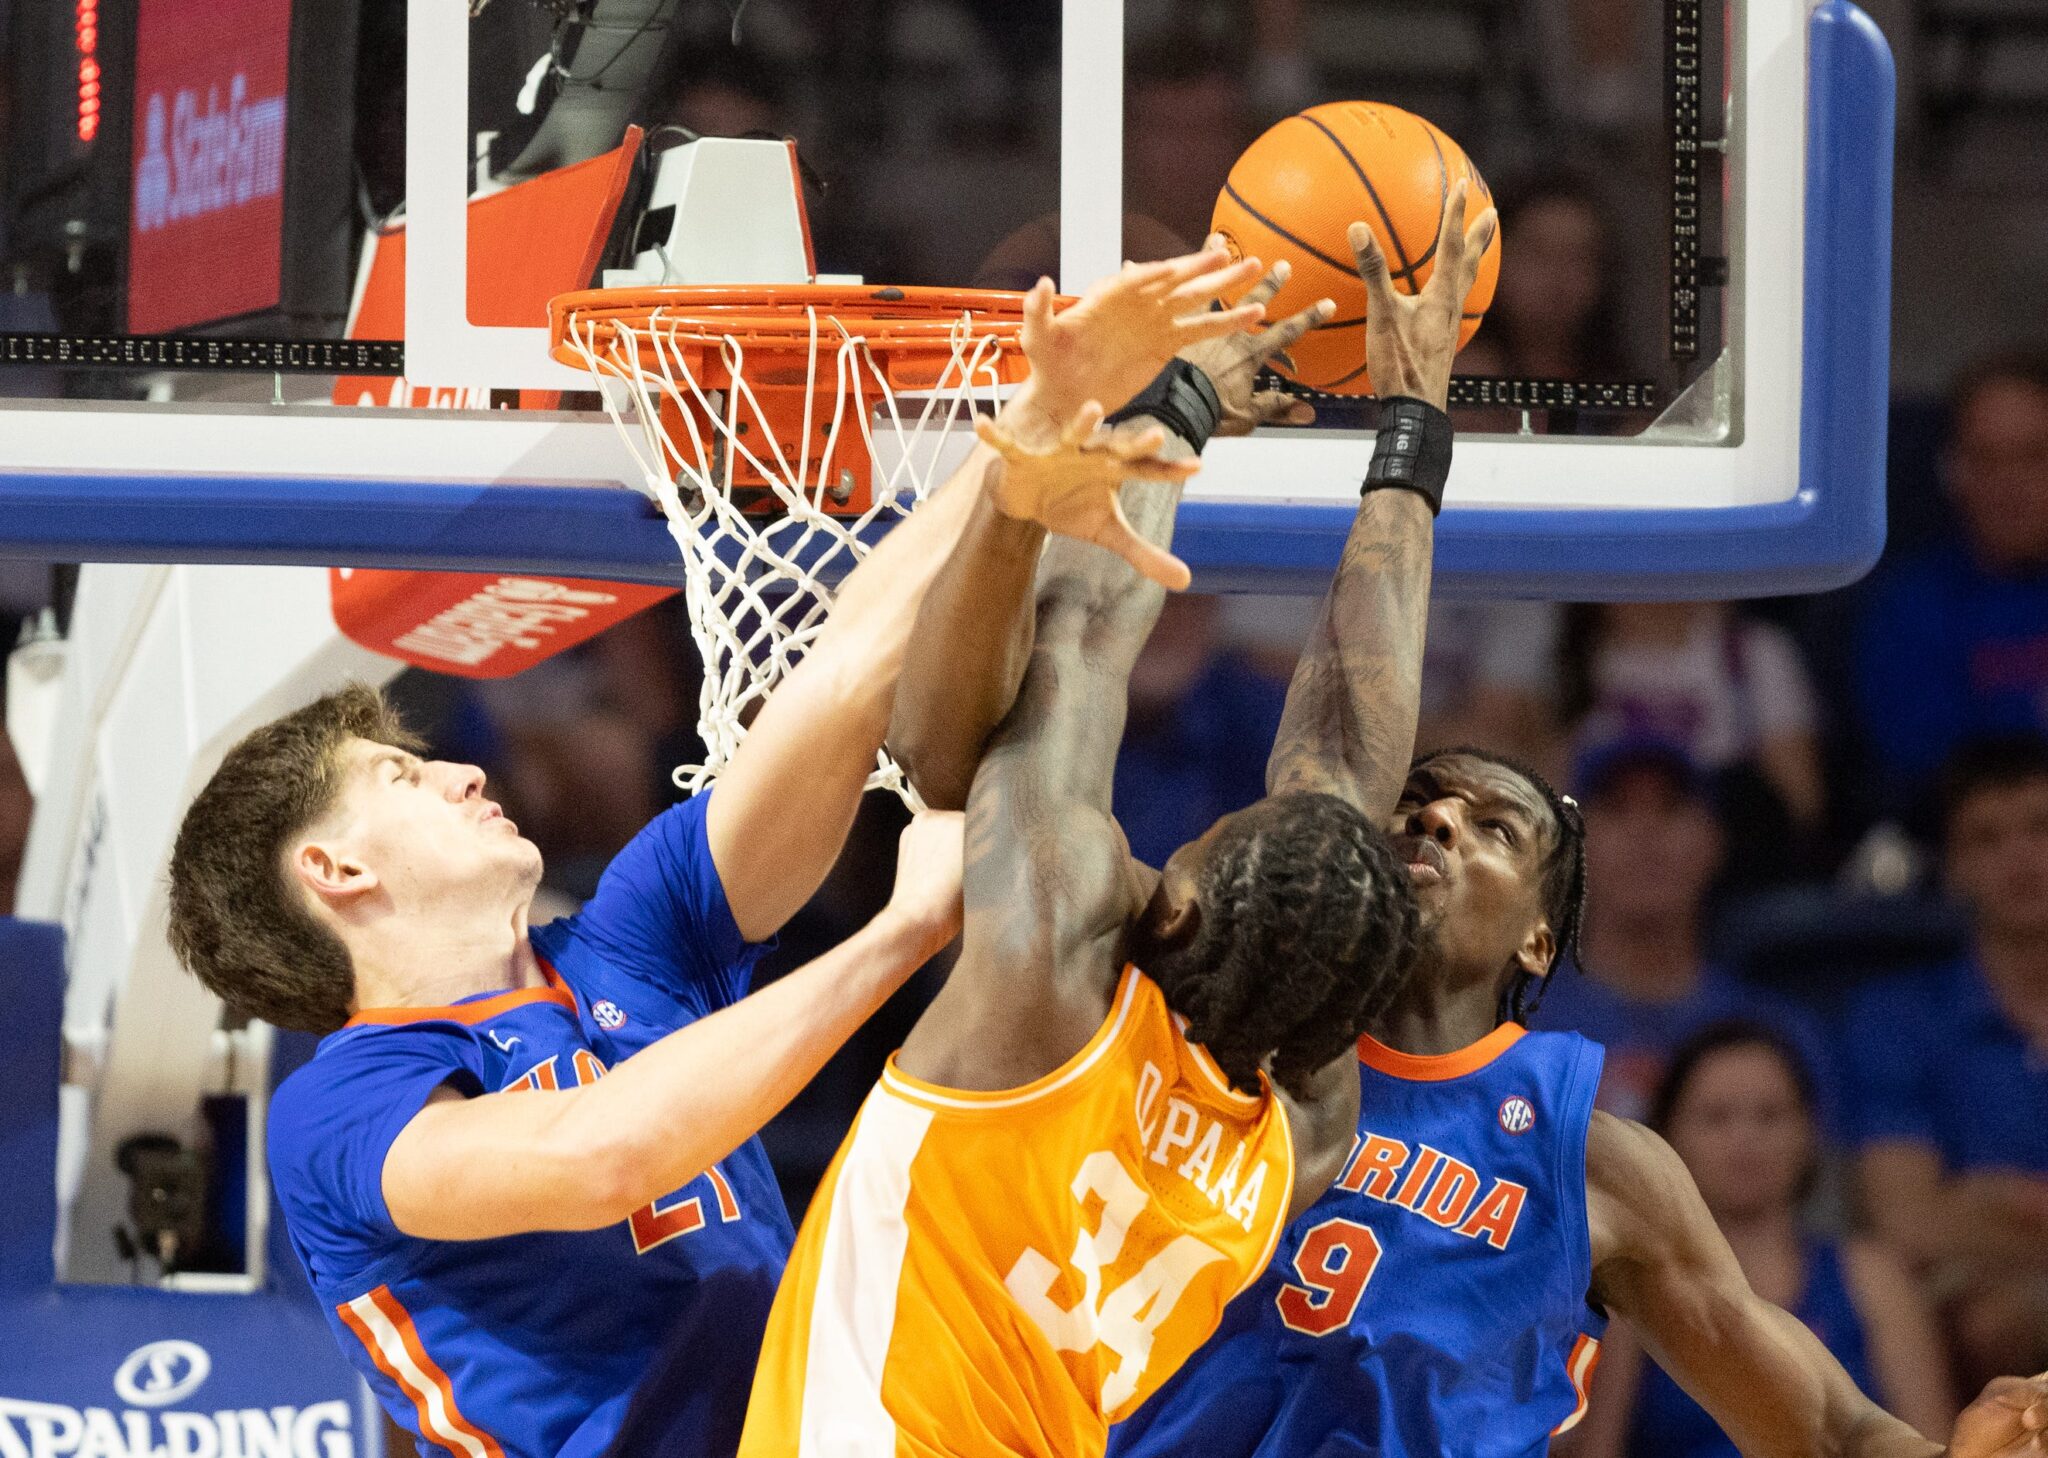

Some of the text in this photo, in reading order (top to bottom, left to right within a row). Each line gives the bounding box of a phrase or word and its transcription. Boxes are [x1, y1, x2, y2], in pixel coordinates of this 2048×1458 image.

[592, 1000, 624, 1029] SEC
[1500, 1098, 1533, 1132] SEC
[1334, 1131, 1528, 1251] RIDA
[1003, 1150, 1231, 1414] 34
[1275, 1216, 1384, 1338] 9
